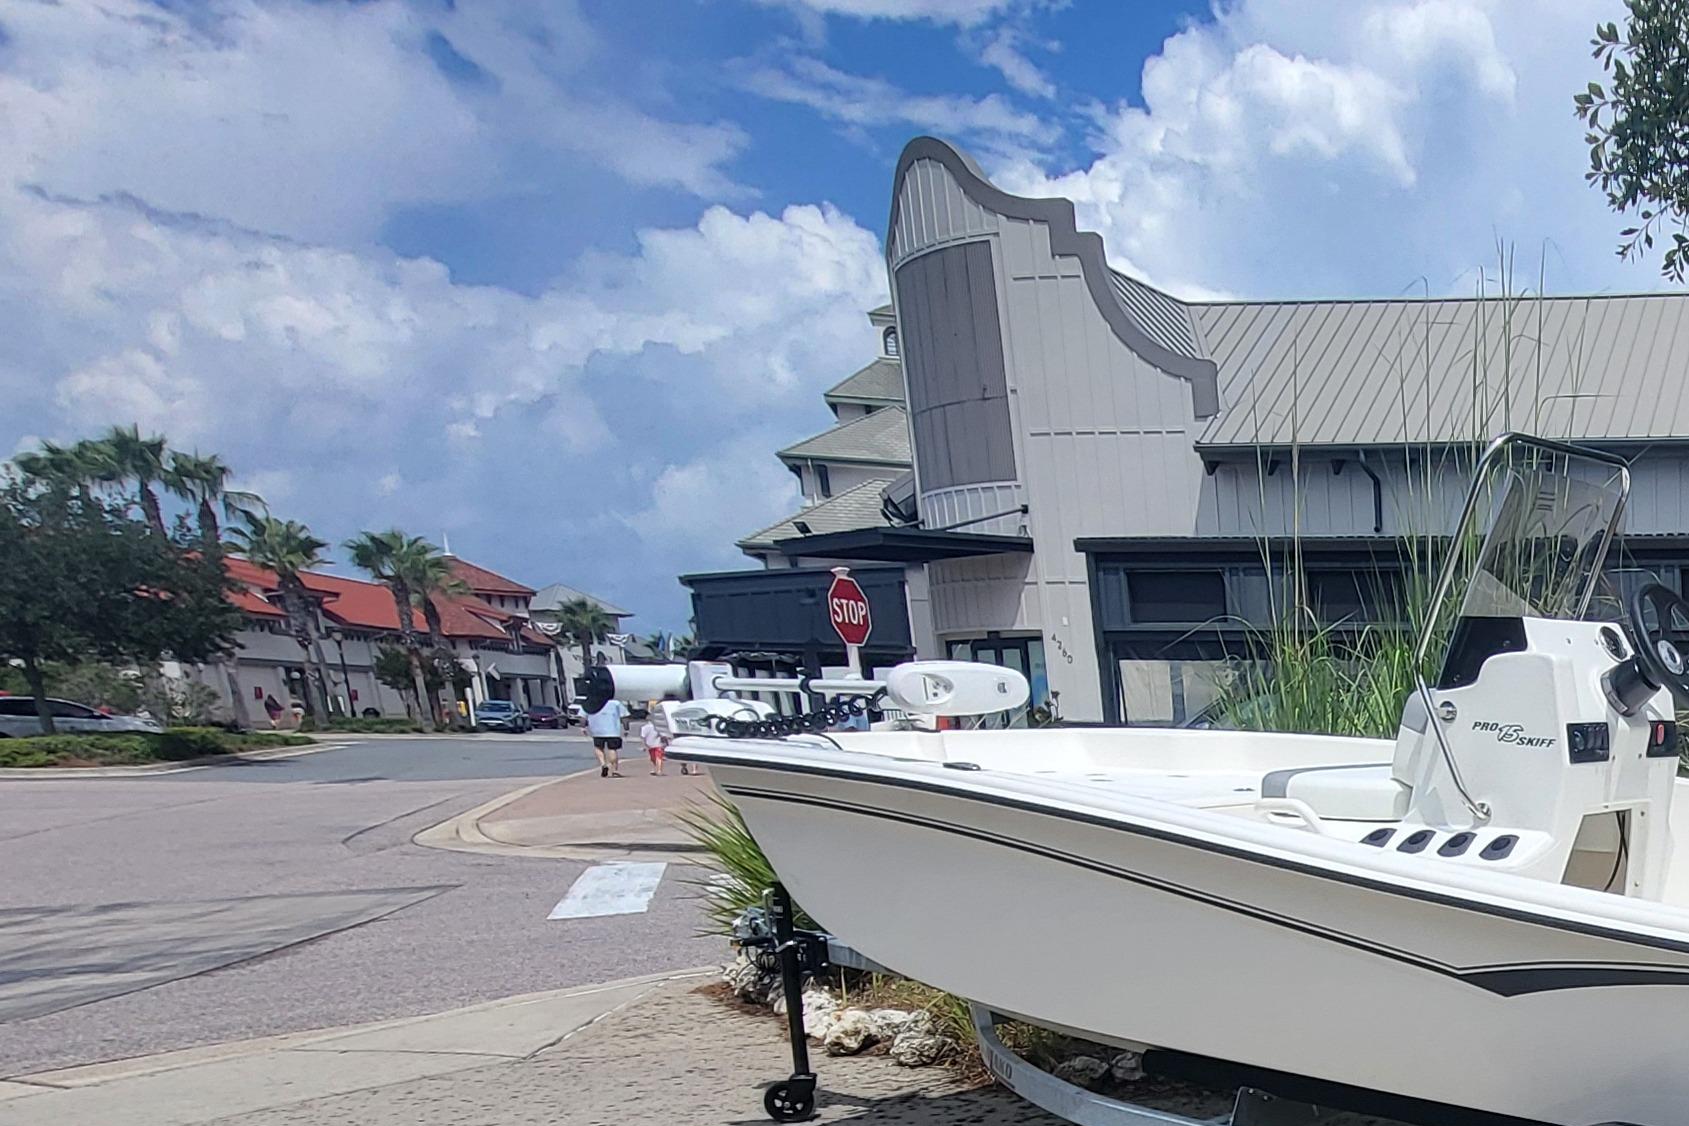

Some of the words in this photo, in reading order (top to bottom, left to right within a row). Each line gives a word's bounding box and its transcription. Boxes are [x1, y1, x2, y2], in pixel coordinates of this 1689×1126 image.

[832, 597, 867, 625] STOP
[1051, 632, 1073, 664] 4260
[1471, 721, 1499, 732] PRO
[1516, 736, 1556, 748] SKIFF
